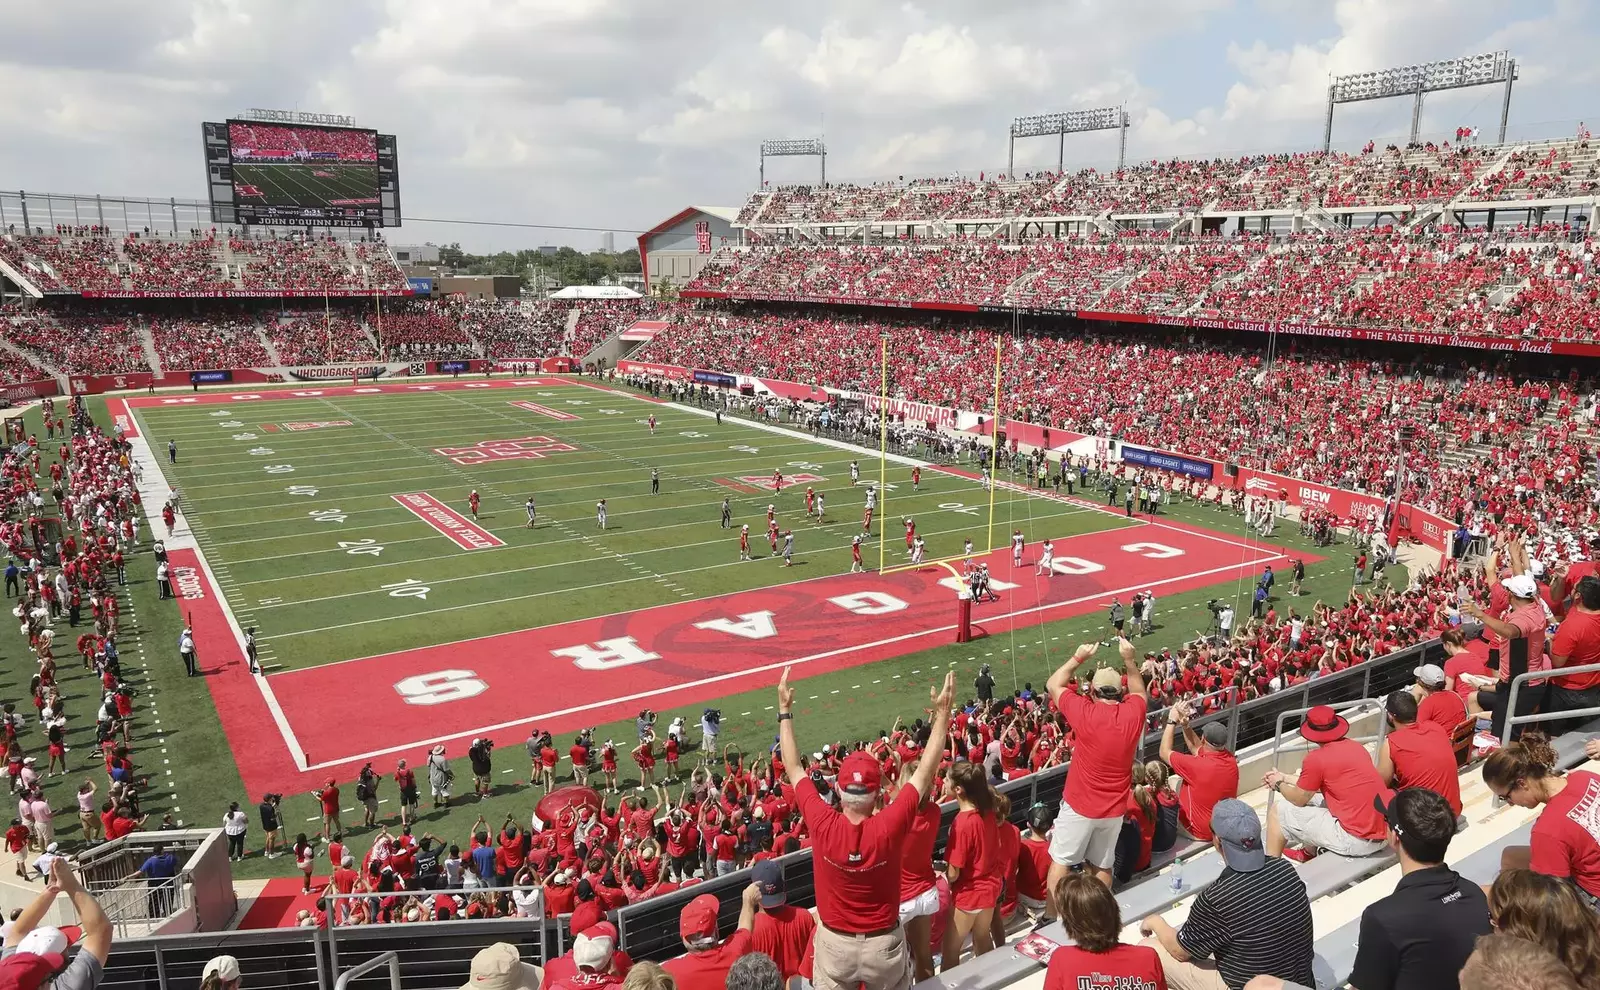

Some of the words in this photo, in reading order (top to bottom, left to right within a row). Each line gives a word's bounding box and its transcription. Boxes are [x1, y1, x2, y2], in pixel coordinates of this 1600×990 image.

[251, 108, 293, 121] TDECU
[299, 112, 352, 126] STADIUM
[259, 217, 288, 225] JOHN
[289, 217, 332, 226] O'QUINN
[334, 219, 363, 227] FIELD
[695, 221, 711, 254] UH
[144, 290, 177, 298] Frozen
[179, 290, 215, 298] Custard
[217, 290, 223, 298] &
[226, 290, 284, 298] Steakburgers
[1193, 318, 1224, 329] Frozen
[1227, 320, 1265, 332] Custard
[1268, 323, 1276, 333] &
[1279, 323, 1352, 338] Steakburgers
[1365, 331, 1383, 341] THE
[1386, 332, 1415, 343] TASTE
[1418, 335, 1445, 345] THAT
[1518, 340, 1553, 354] Back
[901, 401, 958, 428] COUGARS
[1150, 456, 1163, 465] BUD
[1162, 459, 1179, 468] LIGHT
[1299, 487, 1331, 503] IBEW
[308, 508, 348, 523] 30
[1351, 501, 1384, 515] MEMORI
[337, 538, 384, 556] 20
[381, 578, 430, 599] 10
